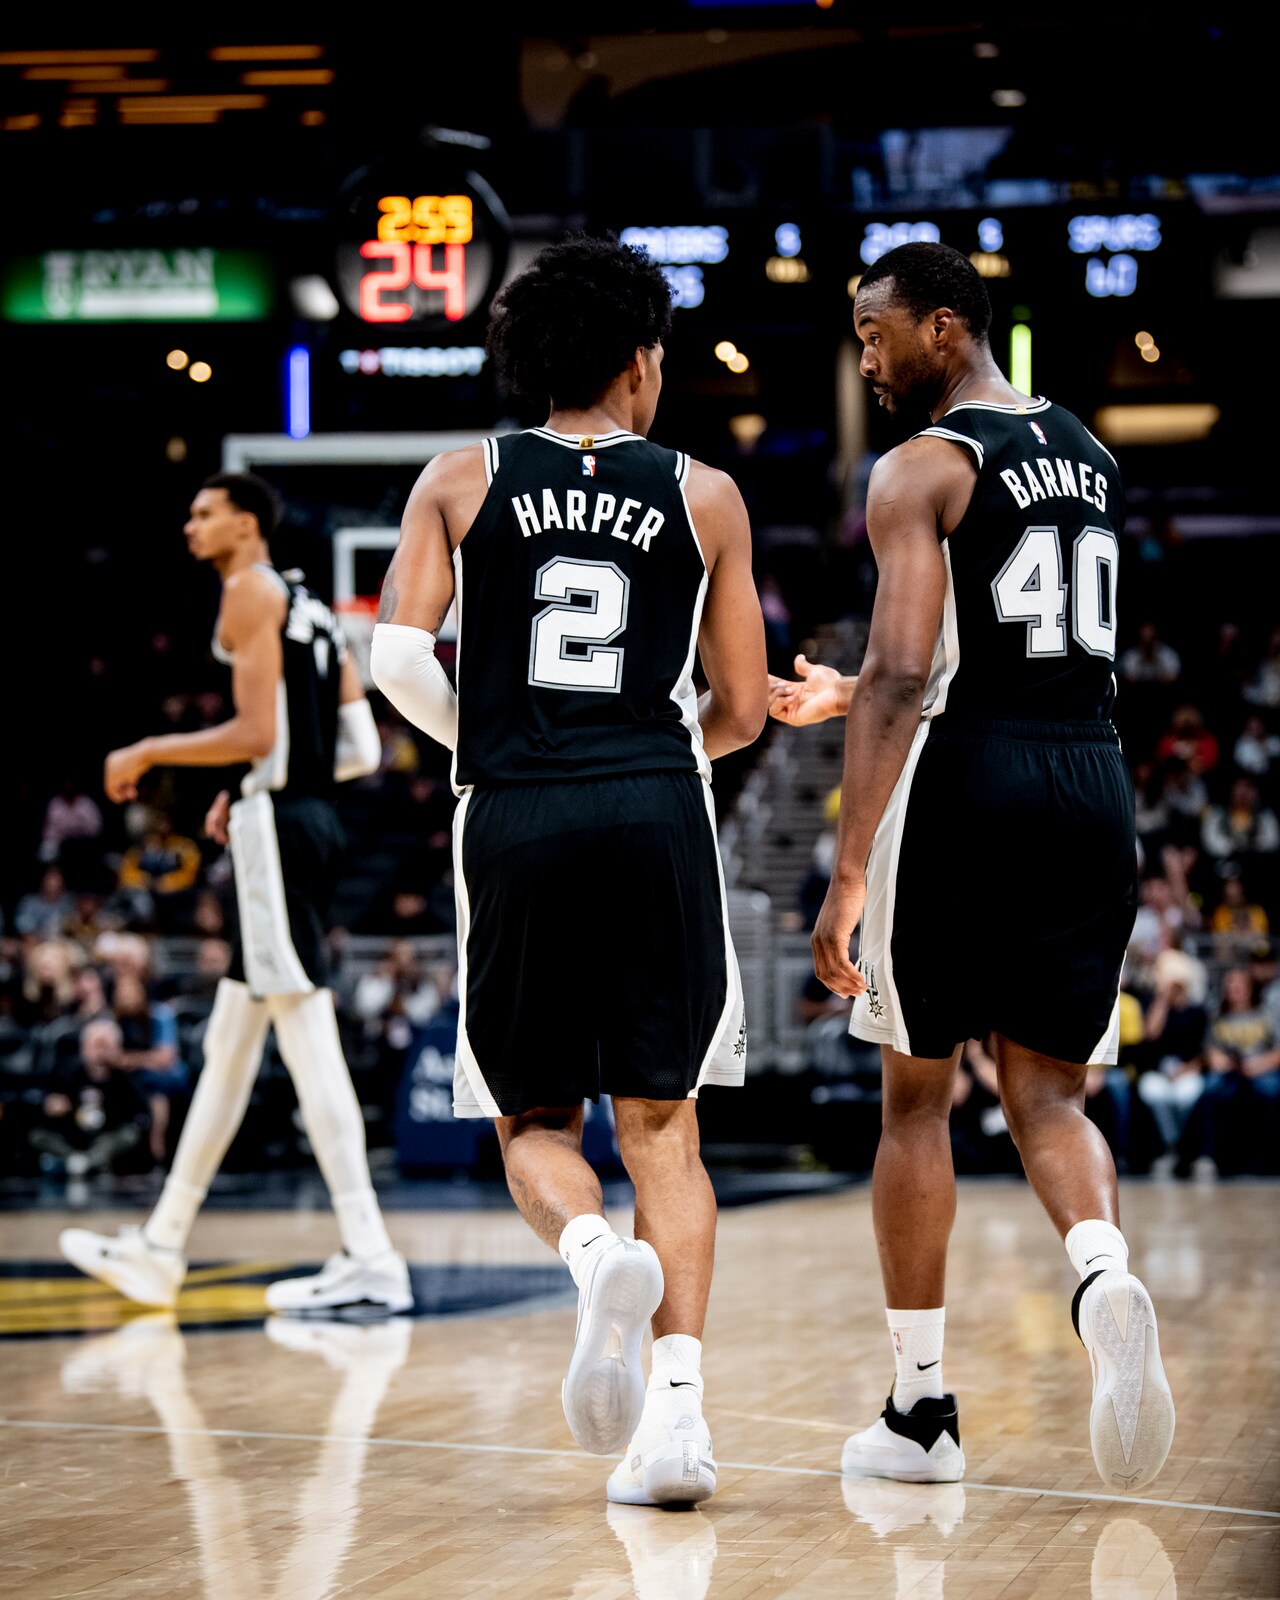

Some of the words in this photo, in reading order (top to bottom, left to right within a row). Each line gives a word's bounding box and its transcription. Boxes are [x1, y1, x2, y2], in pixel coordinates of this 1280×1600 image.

[359, 240, 466, 322] 24
[511, 488, 665, 553] HARPER
[1000, 457, 1107, 513] BARNES
[527, 555, 631, 694] 2
[990, 525, 1119, 662] 40
